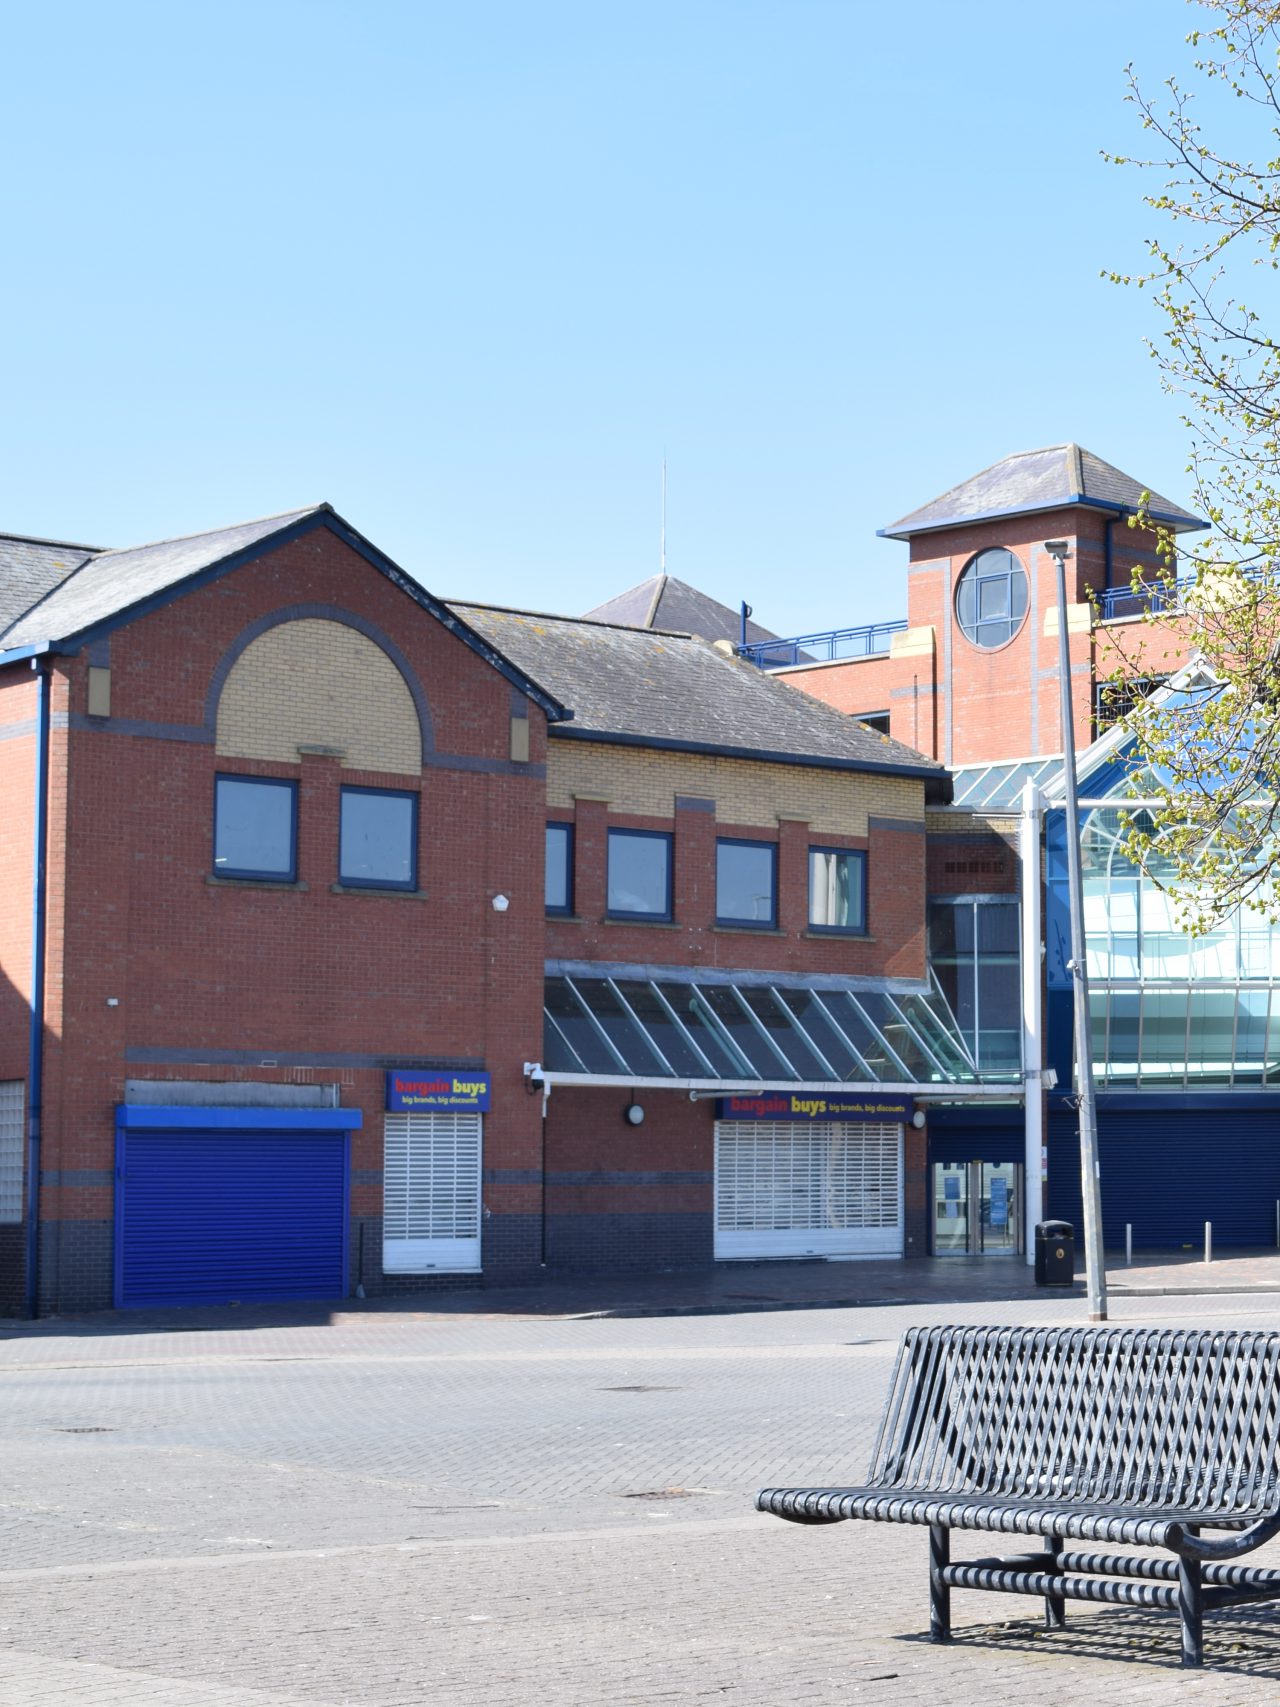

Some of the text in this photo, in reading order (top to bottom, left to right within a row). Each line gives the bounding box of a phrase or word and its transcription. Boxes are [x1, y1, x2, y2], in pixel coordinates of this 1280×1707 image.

[395, 1078, 487, 1097] bargain buys
[402, 1096, 413, 1105] big
[437, 1096, 449, 1105] big
[731, 1096, 788, 1116] bargain
[791, 1096, 827, 1117] buys
[829, 1103, 840, 1113] big
[864, 1104, 876, 1114] big
